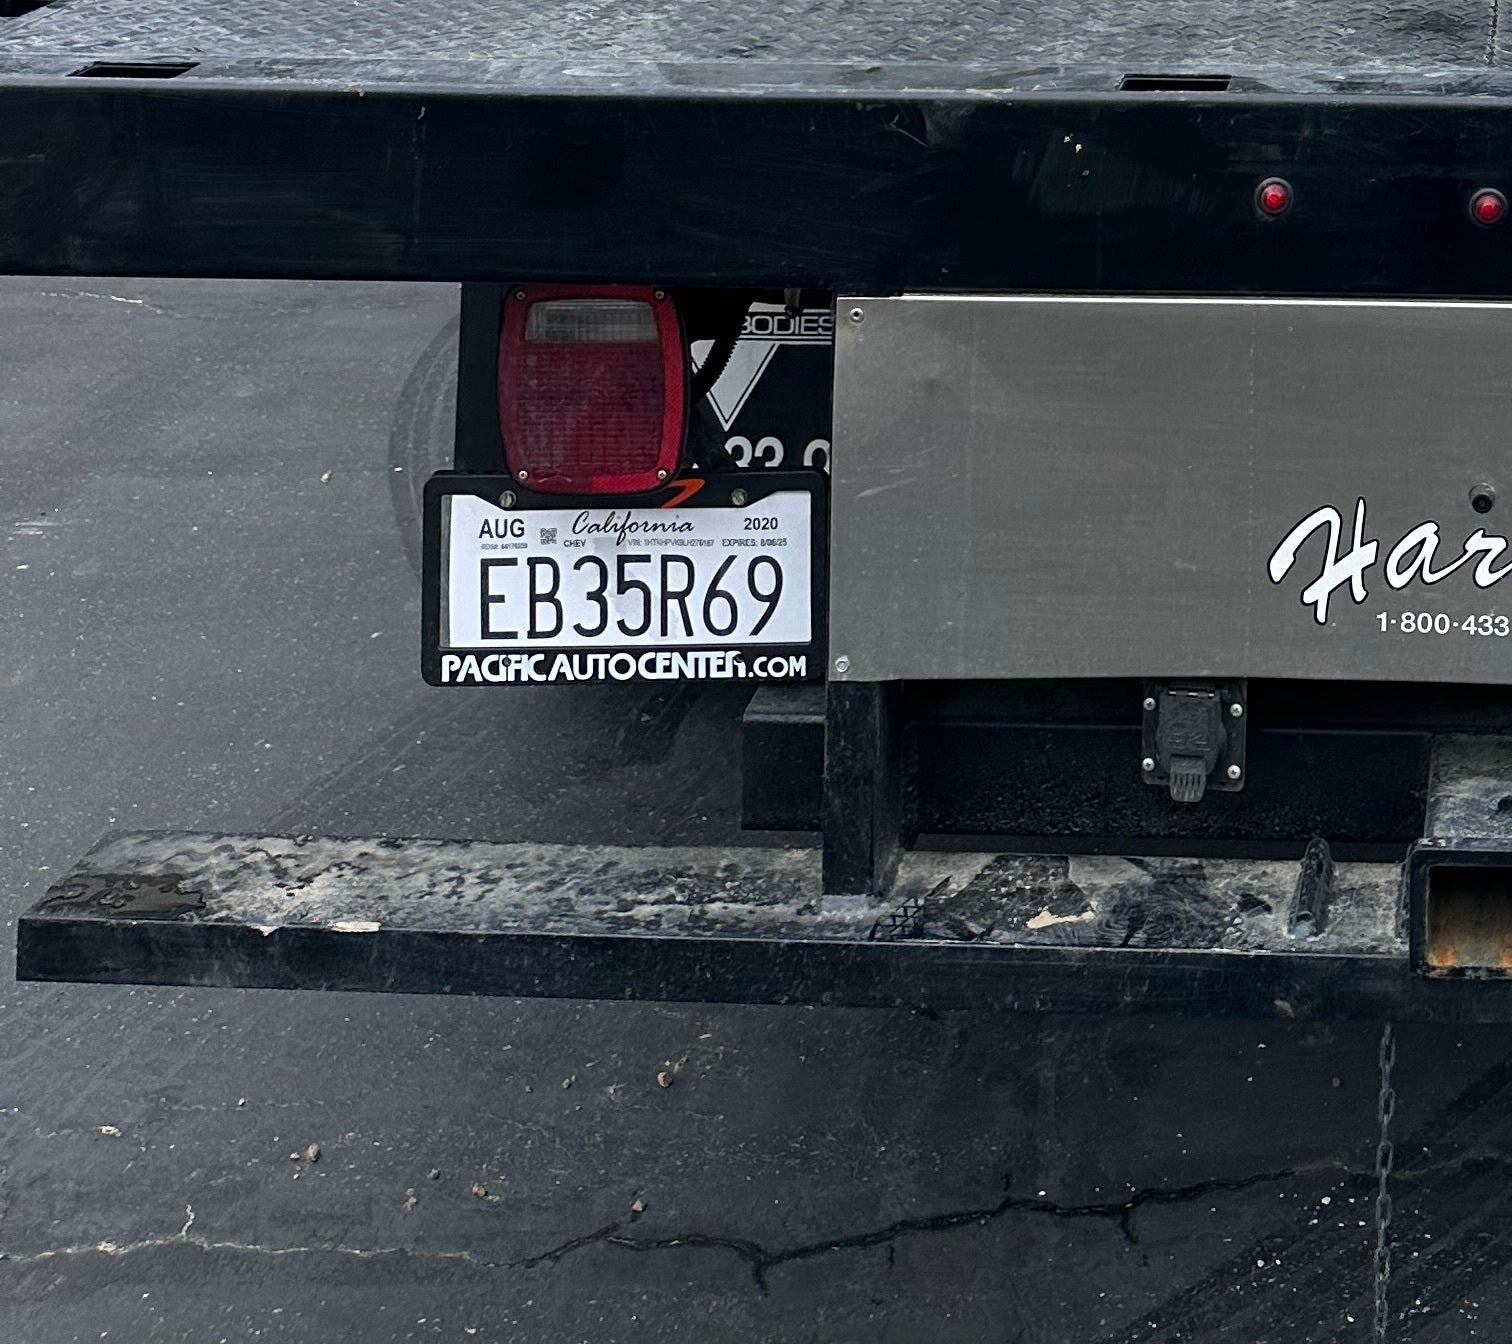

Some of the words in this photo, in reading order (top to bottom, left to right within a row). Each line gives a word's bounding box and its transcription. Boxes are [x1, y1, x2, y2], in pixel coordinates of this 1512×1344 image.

[479, 518, 525, 539] AUG
[572, 511, 695, 546] California
[743, 517, 779, 531] 2020
[563, 539, 587, 548] CHEV
[480, 554, 784, 640] EB35R69
